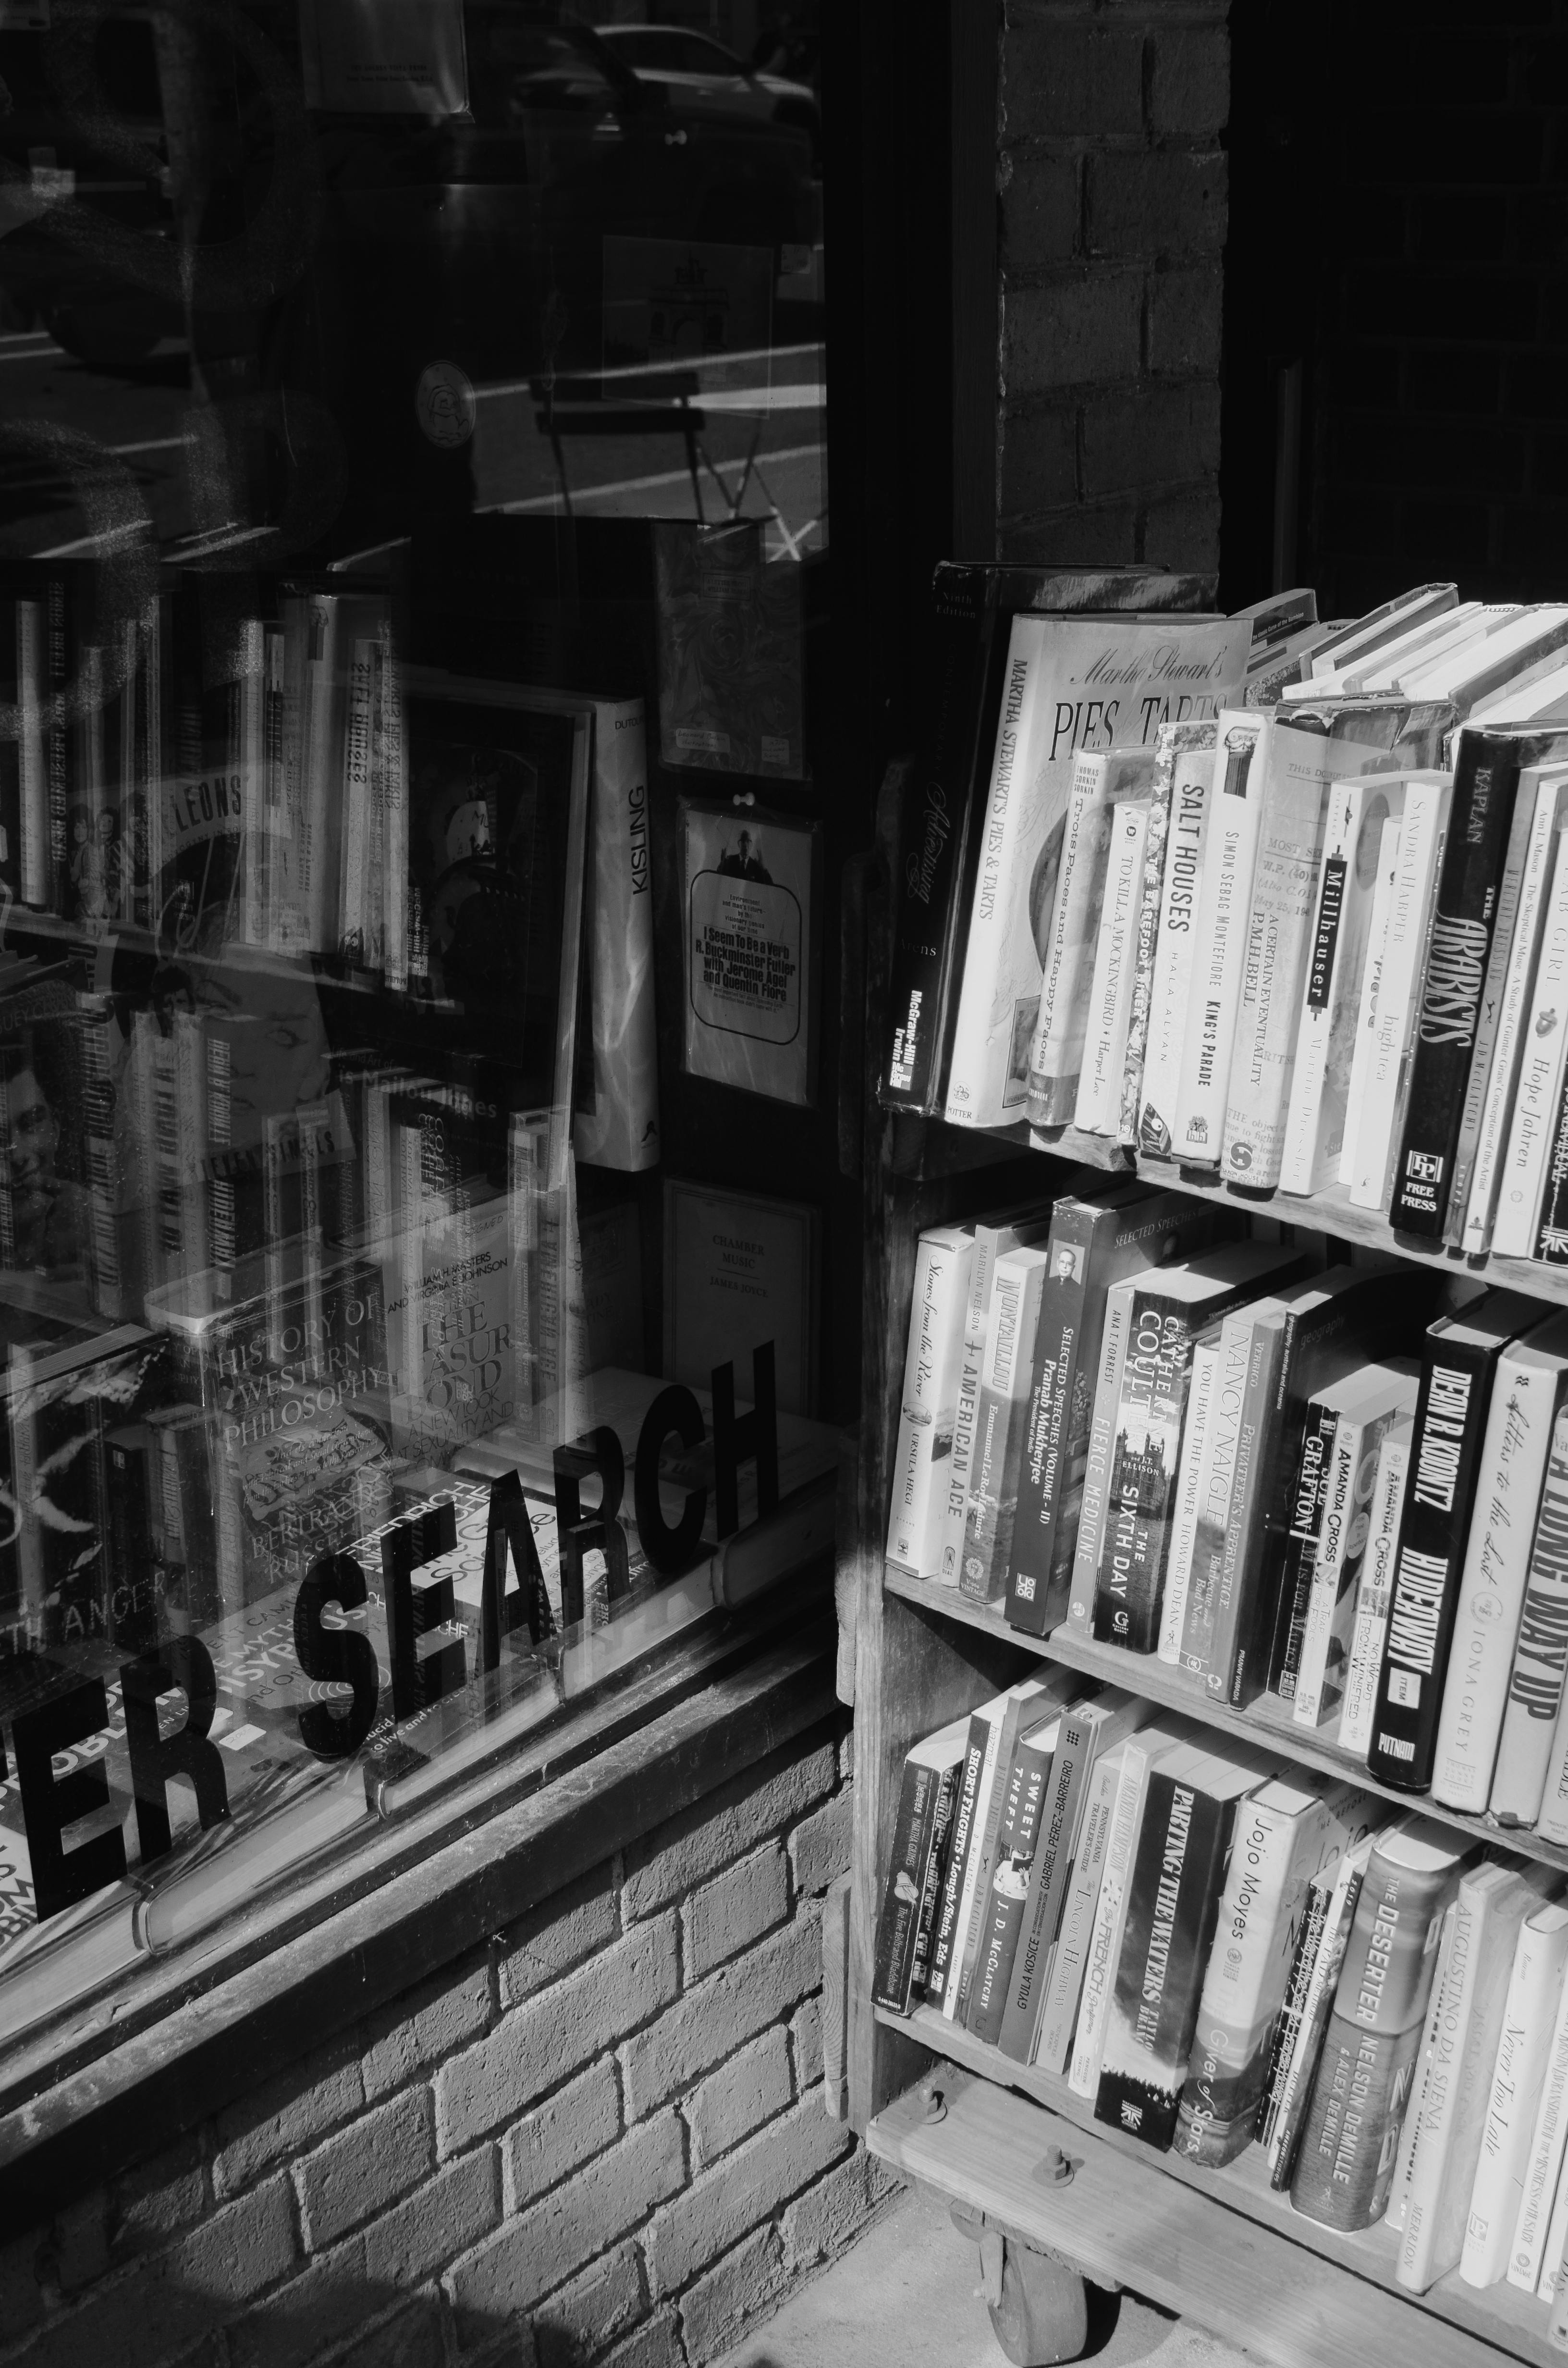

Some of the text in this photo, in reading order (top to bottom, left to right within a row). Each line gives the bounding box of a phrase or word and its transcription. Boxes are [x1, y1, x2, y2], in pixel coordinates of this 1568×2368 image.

[935, 604, 976, 619] Edition
[942, 592, 972, 604] Ninth
[1070, 645, 1227, 685] Martha Stewart's
[980, 658, 1027, 920] MARTHA STEWART'S PIES & TARTS
[1074, 784, 1093, 795] SORKIN
[1076, 775, 1096, 786] SORKIN
[1078, 765, 1099, 777] THOMAS
[1467, 766, 1494, 843] KAPLAN
[1538, 810, 1548, 831] Ann
[628, 785, 650, 895] KISLING
[1531, 843, 1544, 873] Mason
[1392, 799, 1426, 943] SANDRA HARPER
[1527, 884, 1537, 900] The
[704, 926, 790, 960] I Seem To Be a Verb
[899, 938, 937, 957] Arens
[1038, 799, 1083, 1070] Trots Paces and Happy Faces
[1160, 784, 1205, 1061] SALT HOUSES HALA ALYAN
[1311, 869, 1343, 997] Millhauser
[1520, 902, 1533, 944] Skeptical
[696, 939, 796, 976] R. Buckminster Fuller
[704, 956, 787, 988] with Jerome Agel
[704, 970, 720, 985] and
[723, 973, 759, 995] Quentin
[762, 983, 787, 1002] Fiore
[1198, 831, 1239, 1086] SIMON SEBAG MONTEFIORE KING'S PARADE
[1420, 910, 1488, 1047] ARABISTS
[892, 1027, 906, 1061] Irwin
[904, 989, 922, 1066] McGraw-Hill
[947, 1106, 972, 1119] POTTER
[1487, 1087, 1504, 1139] Conception
[1516, 1058, 1550, 1168] Hope Jahren
[1401, 1195, 1437, 1212] PRESS
[1406, 1182, 1434, 1197] FREE
[1478, 1162, 1489, 1190] Artist
[712, 1234, 765, 1256] CHAMBER
[722, 1252, 755, 1269] MUSIC
[710, 1276, 769, 1297] JAMES JOYCE
[217, 1310, 336, 1379] HISTORY
[992, 1276, 1020, 1391] MONTAILLOU
[239, 1336, 360, 1407] WESTERN
[948, 1245, 987, 1518] MARILYN NELSON AMERICAN ACE
[1148, 1316, 1179, 1454] CATHERINE
[224, 1367, 382, 1452] PHILOSOPHY
[1030, 1358, 1057, 1485] Pranab Mukherjee
[1205, 1332, 1249, 1527] NANCY NAIGLE
[908, 1433, 919, 1474] URSULA
[1123, 1461, 1159, 1476] ELLISON
[1219, 1341, 1264, 1609] VERRICO PRIVATEER'S APPRENTICE
[1295, 1436, 1324, 1530] GRAFTON
[905, 1477, 914, 1506] HEGI
[1170, 1364, 1213, 1626] YOU HAVE THE POWER HOWARD DEAN
[1325, 1448, 1351, 1564] AMANDA CROSS
[1110, 1484, 1139, 1598] SIXTH DAY
[1134, 1531, 1148, 1562] THE
[1374, 1471, 1400, 1588] AMANDA CROSS
[961, 1582, 985, 1597] VINTAGE
[1387, 1546, 1449, 1675] HIDEAWAY
[0, 1339, 779, 1924] ER SEARCH
[1232, 1675, 1242, 1701] VARADA
[1399, 1677, 1407, 1700] ITEM
[1456, 1629, 1485, 1752] IONA GREY
[962, 1747, 981, 1794] SHORT
[984, 1726, 1000, 1766] hazmat
[1378, 1732, 1415, 1762] PUTNAM
[954, 1795, 974, 1855] FLIGHTS
[1005, 1767, 1024, 1830] THEFT
[1020, 1772, 1041, 1839] SWEET
[1092, 1805, 1110, 1863] PENNSYLVANIA
[937, 1862, 961, 1939] Lough/Stein,
[1017, 1760, 1073, 2010] GYULA KOSICE GABRIEL PÉREZ-BARREIRO
[1141, 1786, 1195, 2004] PARTING THE WATERS
[1232, 1818, 1273, 1940] Jojo Moyes
[935, 1940, 948, 1966] Eds
[1054, 1887, 1091, 2010] LINCOLN HIGHWAY
[1356, 1878, 1399, 2022] THE DESERTER
[1444, 1904, 1471, 2032] AUGUSTINO
[1437, 2035, 1454, 2064] DA
[1425, 2072, 1449, 2131] SIENA
[1521, 2153, 1548, 2246] MISTRESS HUSABY
[1403, 2202, 1423, 2269] MERRION
[1511, 2263, 1532, 2279] VINTAGE
